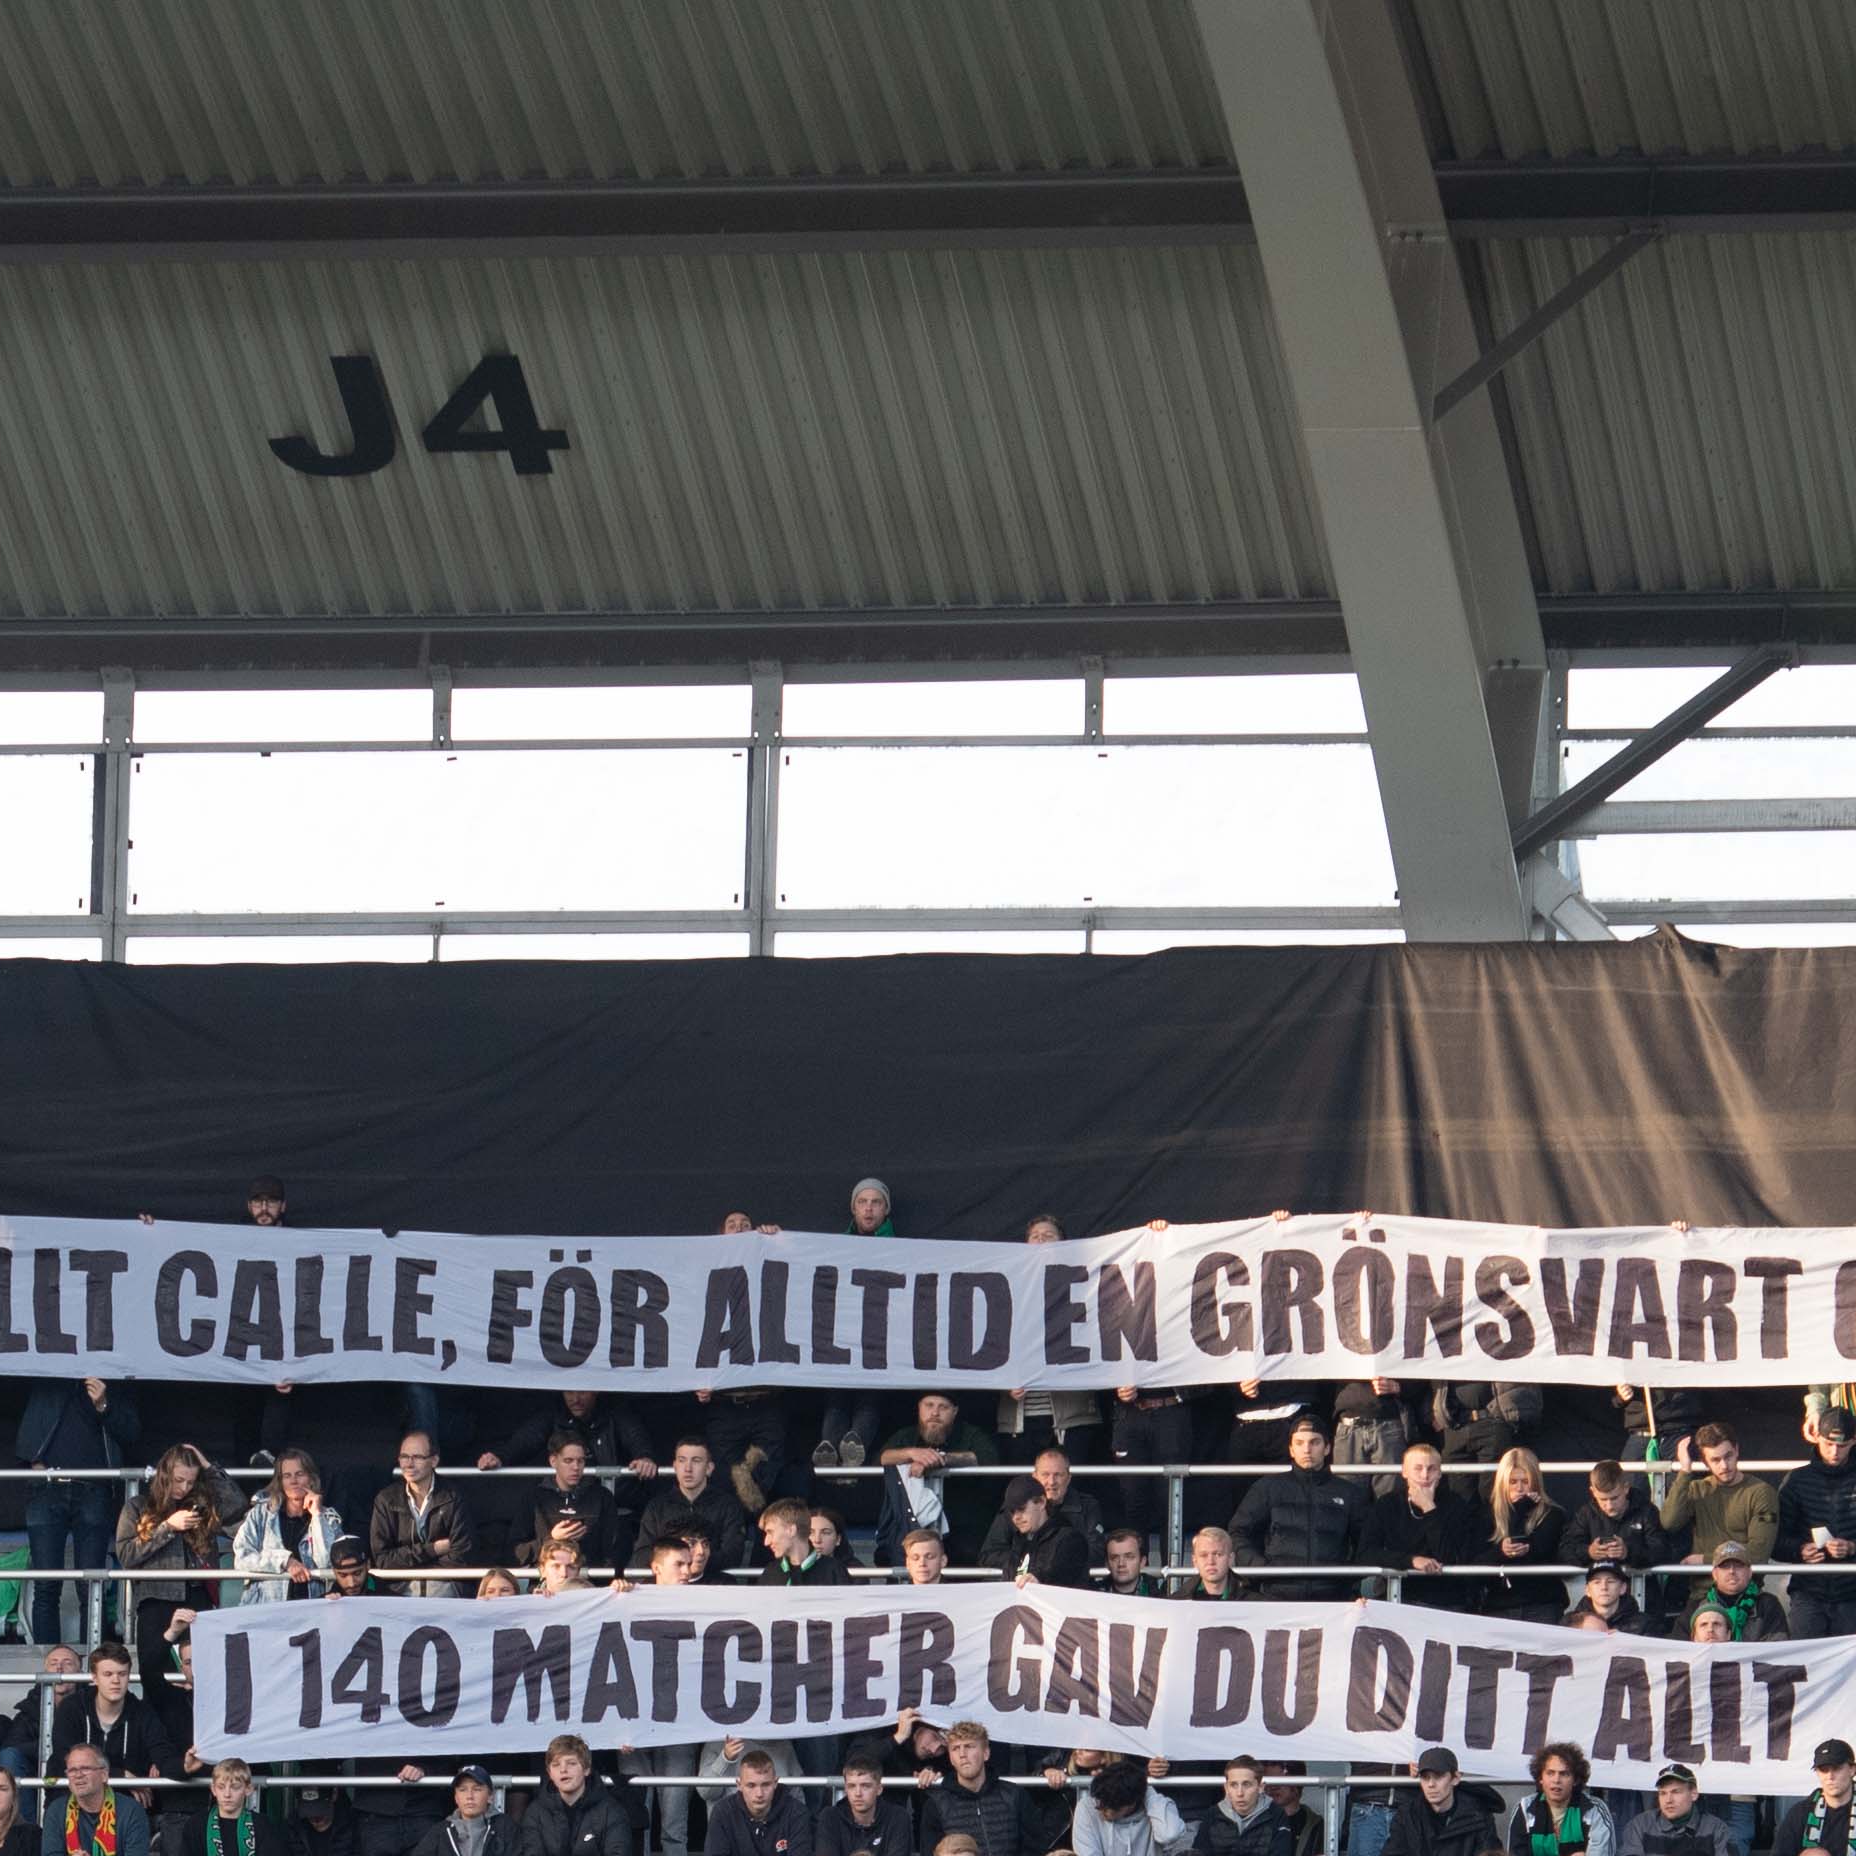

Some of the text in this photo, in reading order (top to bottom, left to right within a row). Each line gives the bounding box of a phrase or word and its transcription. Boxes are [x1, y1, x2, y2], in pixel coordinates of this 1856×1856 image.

[268, 355, 570, 477] J4
[155, 1250, 457, 1371] CALLE,
[487, 1249, 669, 1368] FÖR
[696, 1260, 1012, 1370] ALLTID
[1045, 1264, 1157, 1365] EN
[1191, 1229, 1803, 1361] GRÖNSVART
[224, 1605, 1807, 1764] I 140 MATCHER GAV DU DITT ALLT
